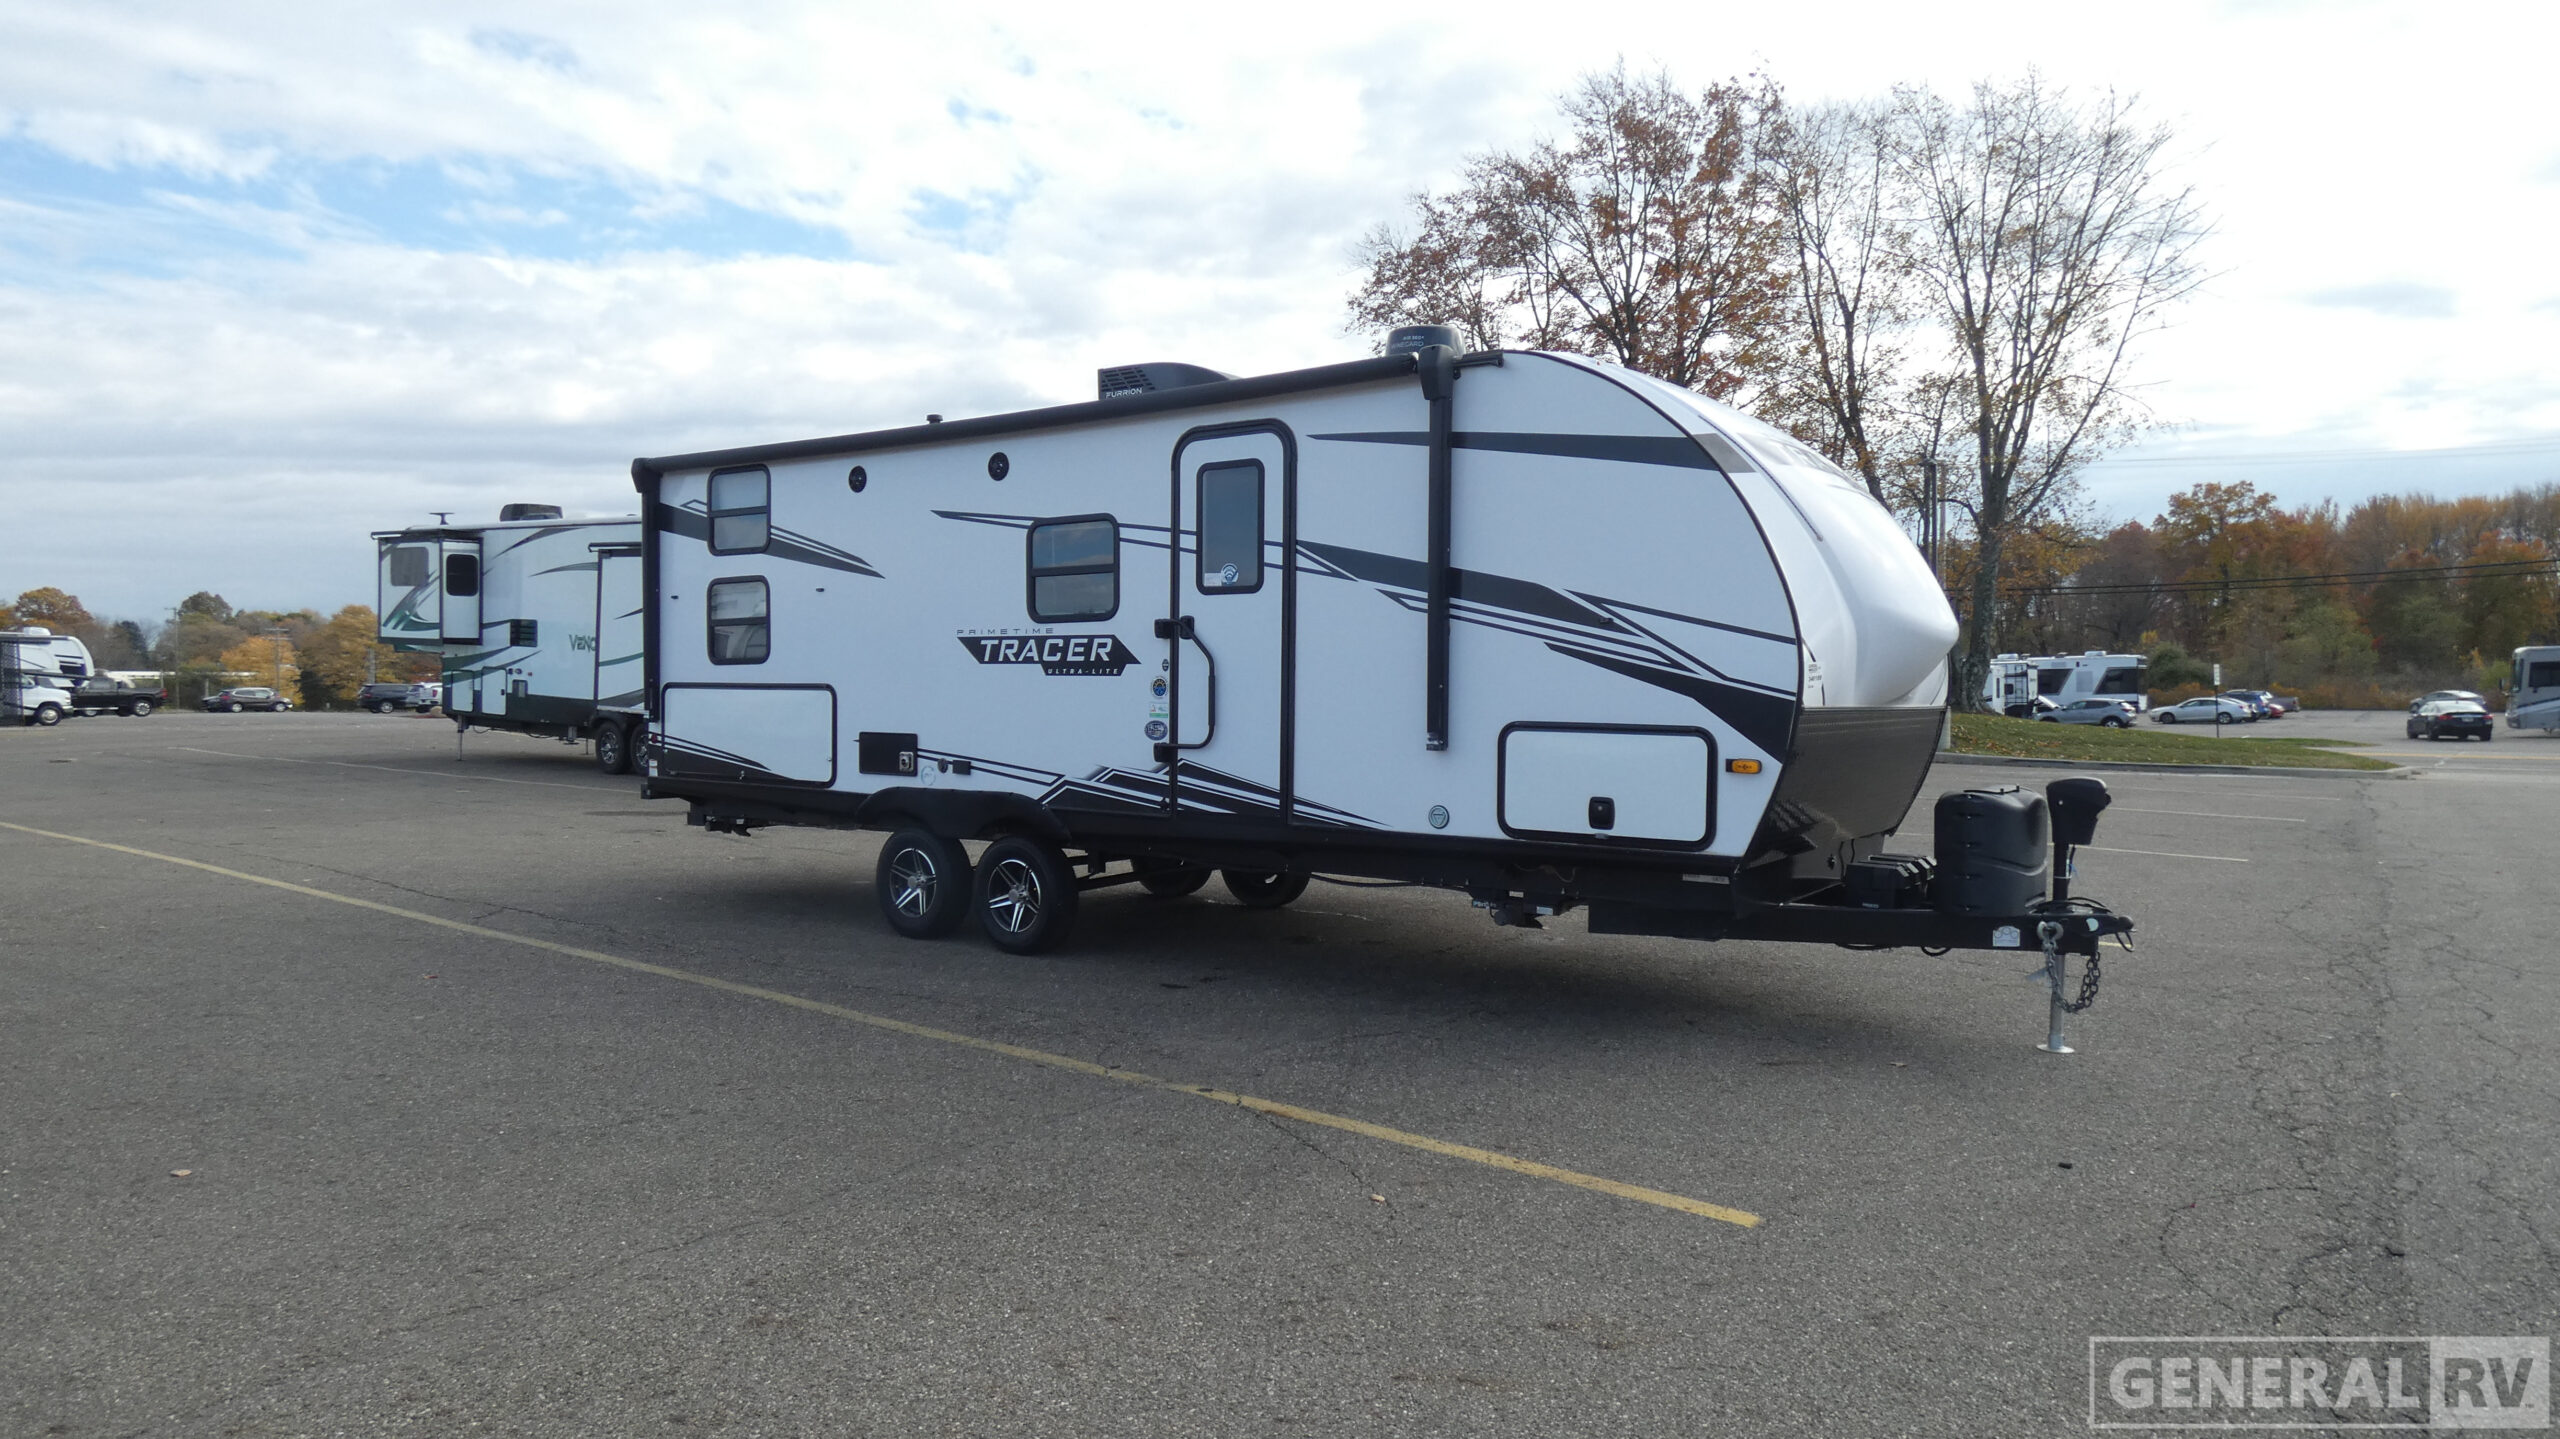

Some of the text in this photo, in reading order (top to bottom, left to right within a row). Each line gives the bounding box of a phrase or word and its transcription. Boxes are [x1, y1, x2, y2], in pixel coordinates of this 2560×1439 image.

[1105, 387, 1143, 399] FURRION
[956, 627, 1054, 635] PRIMETIME
[979, 637, 1113, 662] TRACER
